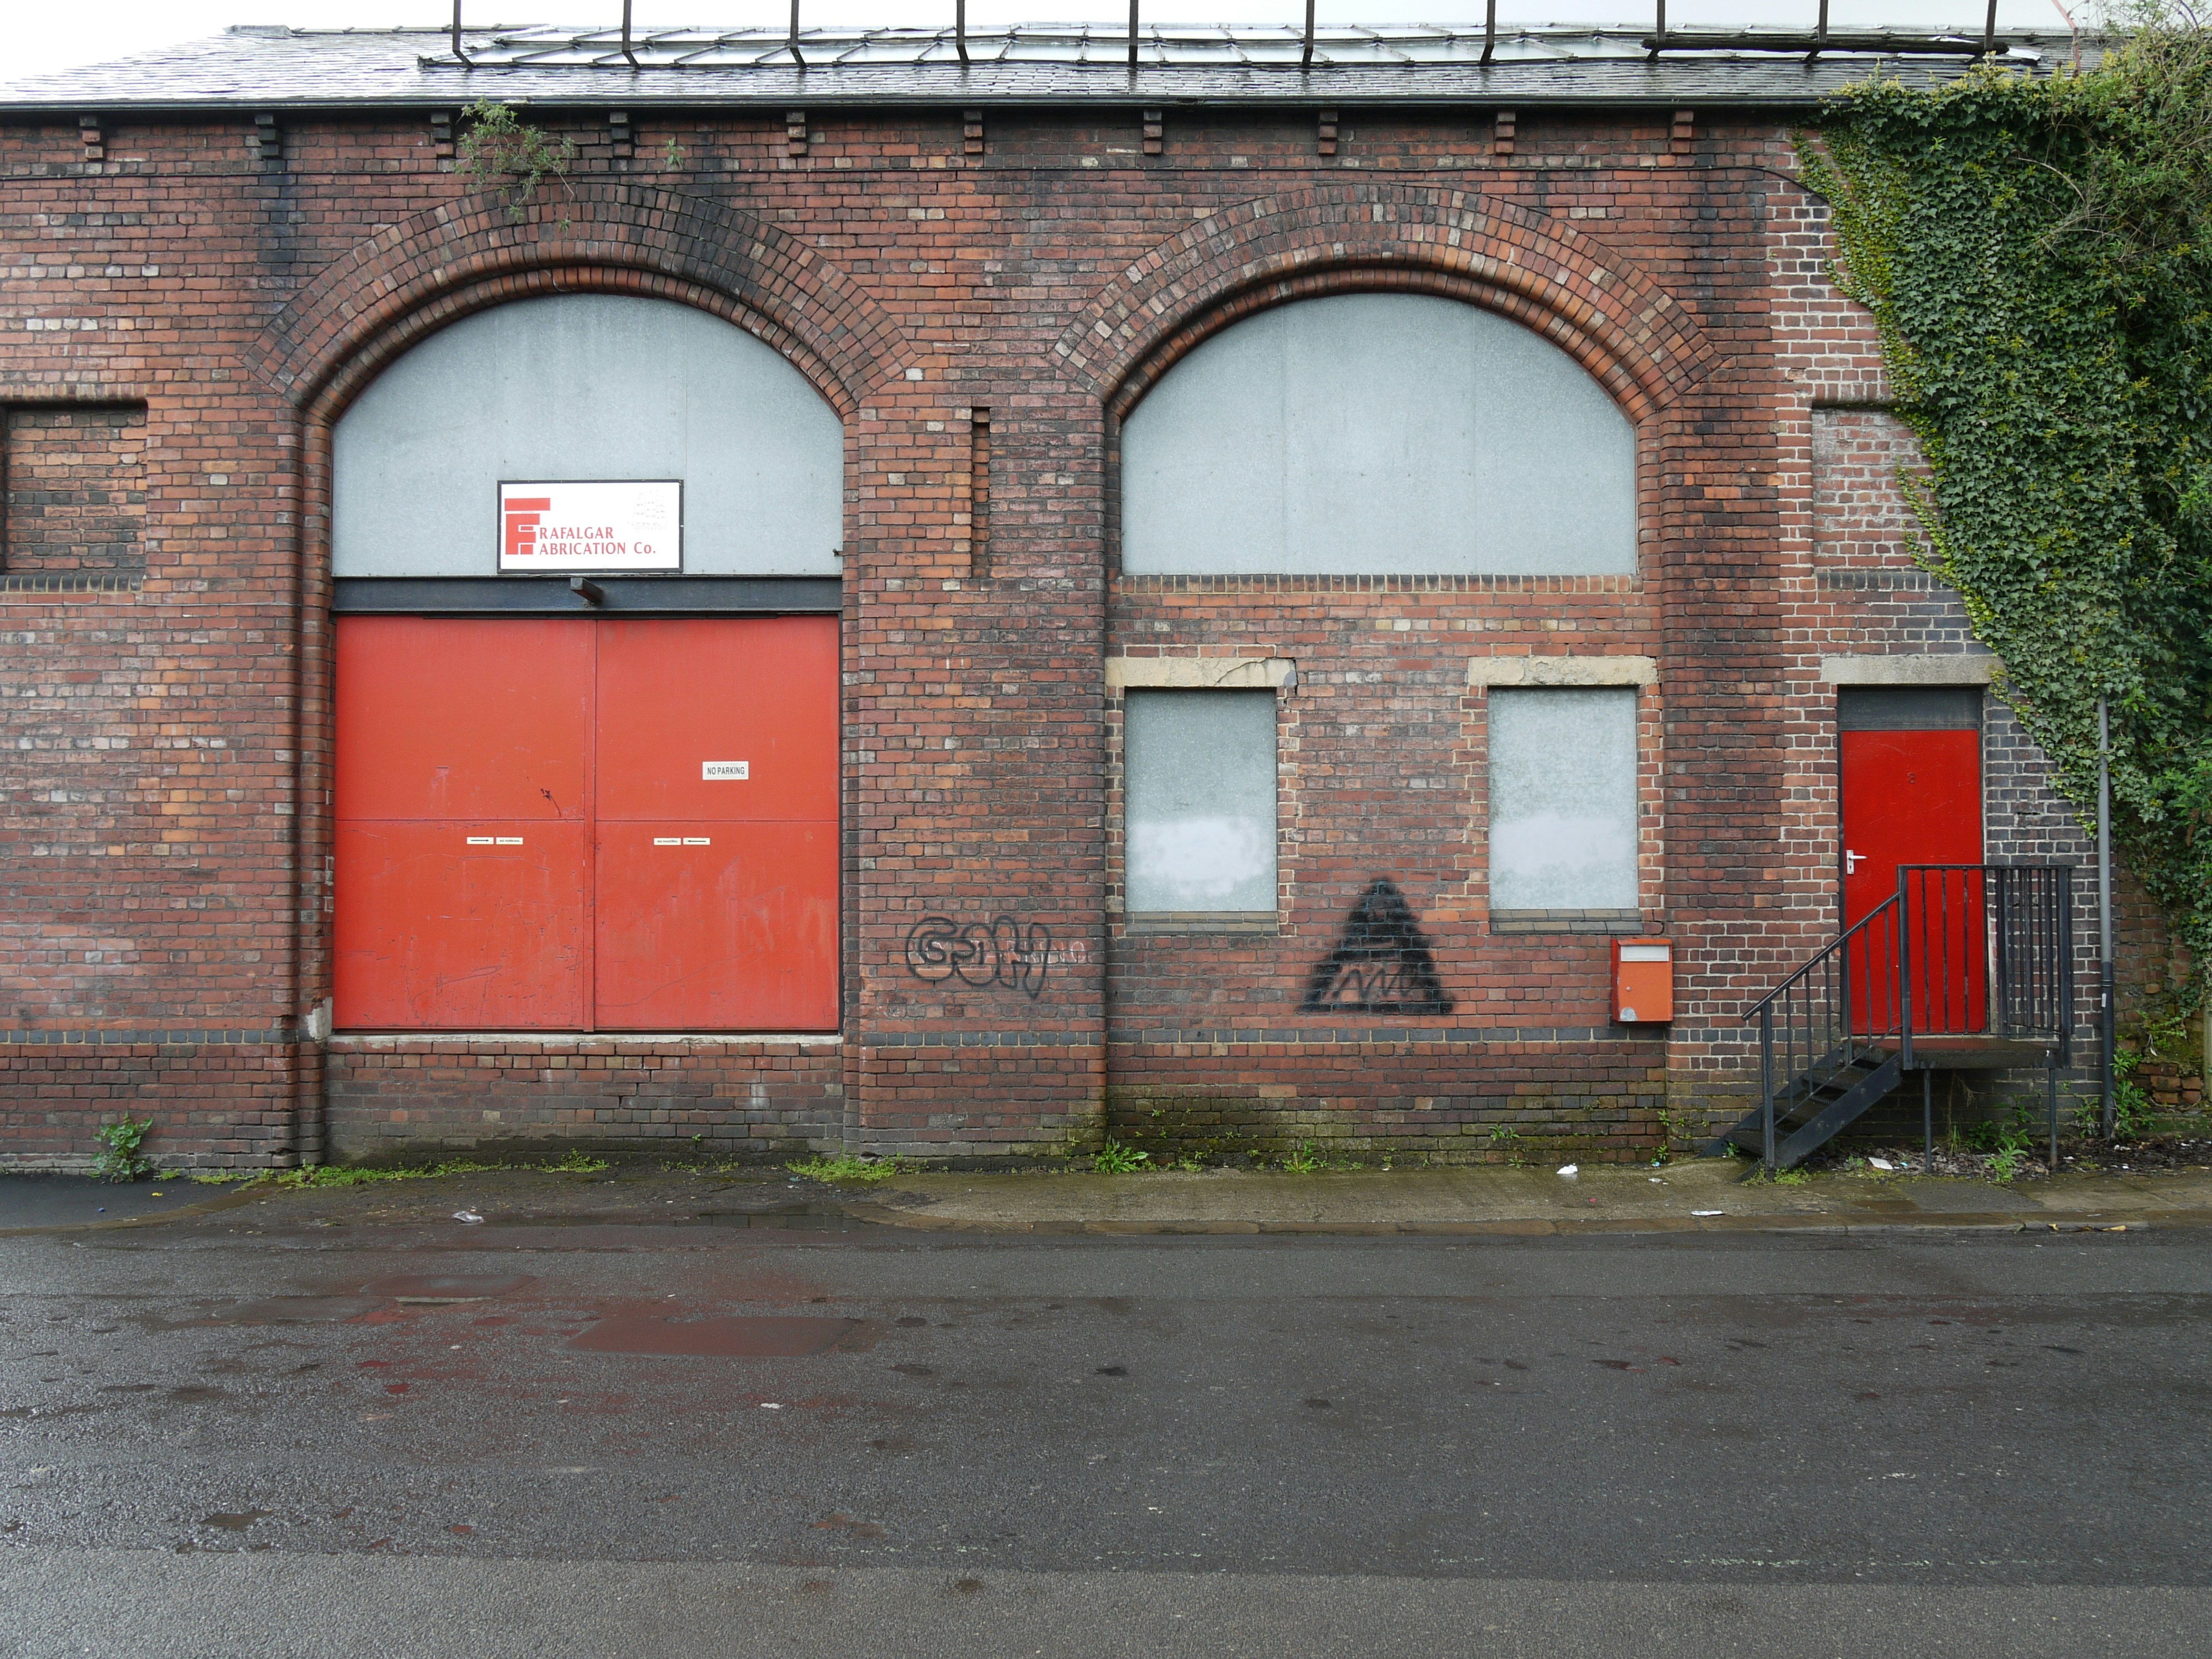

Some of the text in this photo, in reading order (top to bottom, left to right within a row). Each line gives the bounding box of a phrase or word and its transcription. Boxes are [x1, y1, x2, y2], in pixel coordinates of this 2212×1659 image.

[634, 542, 656, 554] Co.
[707, 766, 745, 775] NO PARKING
